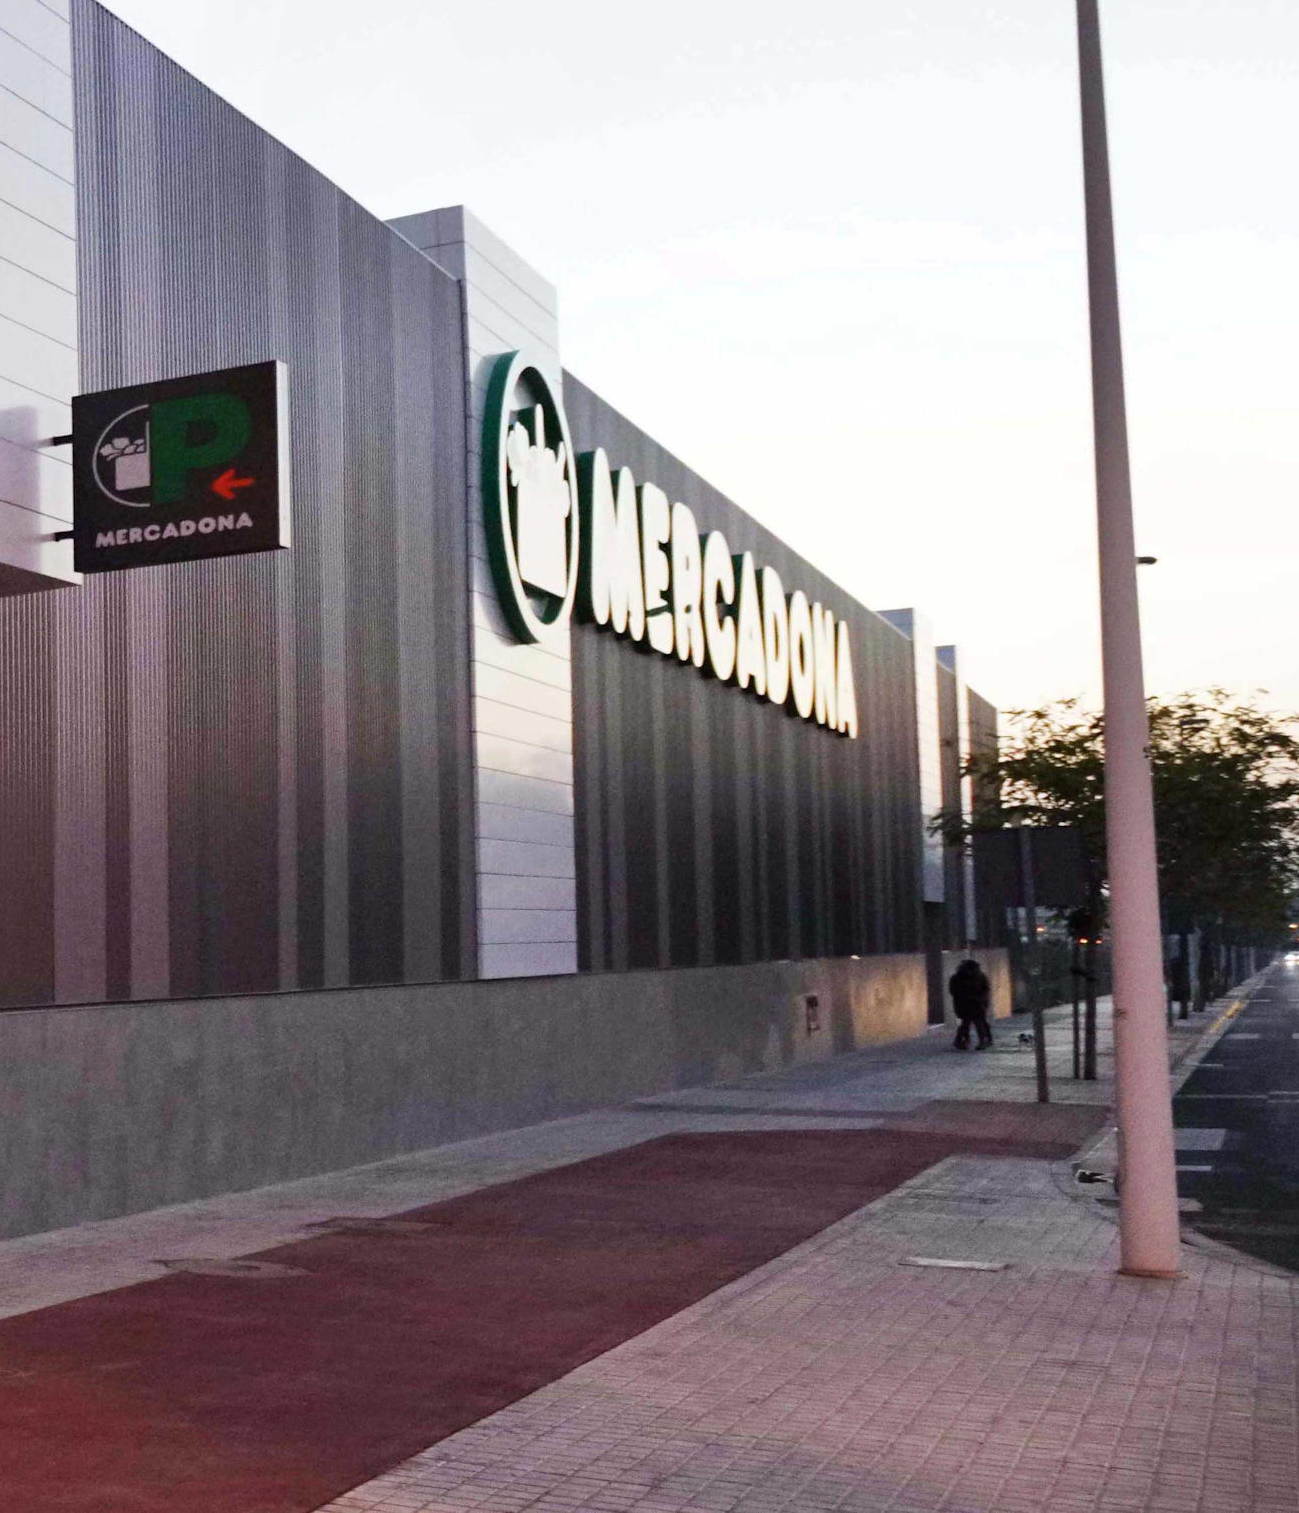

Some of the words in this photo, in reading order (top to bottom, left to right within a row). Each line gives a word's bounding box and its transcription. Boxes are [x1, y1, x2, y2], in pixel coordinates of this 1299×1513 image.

[154, 391, 251, 504] P
[95, 511, 254, 549] MERCADONA
[588, 447, 858, 739] MERCADONA
